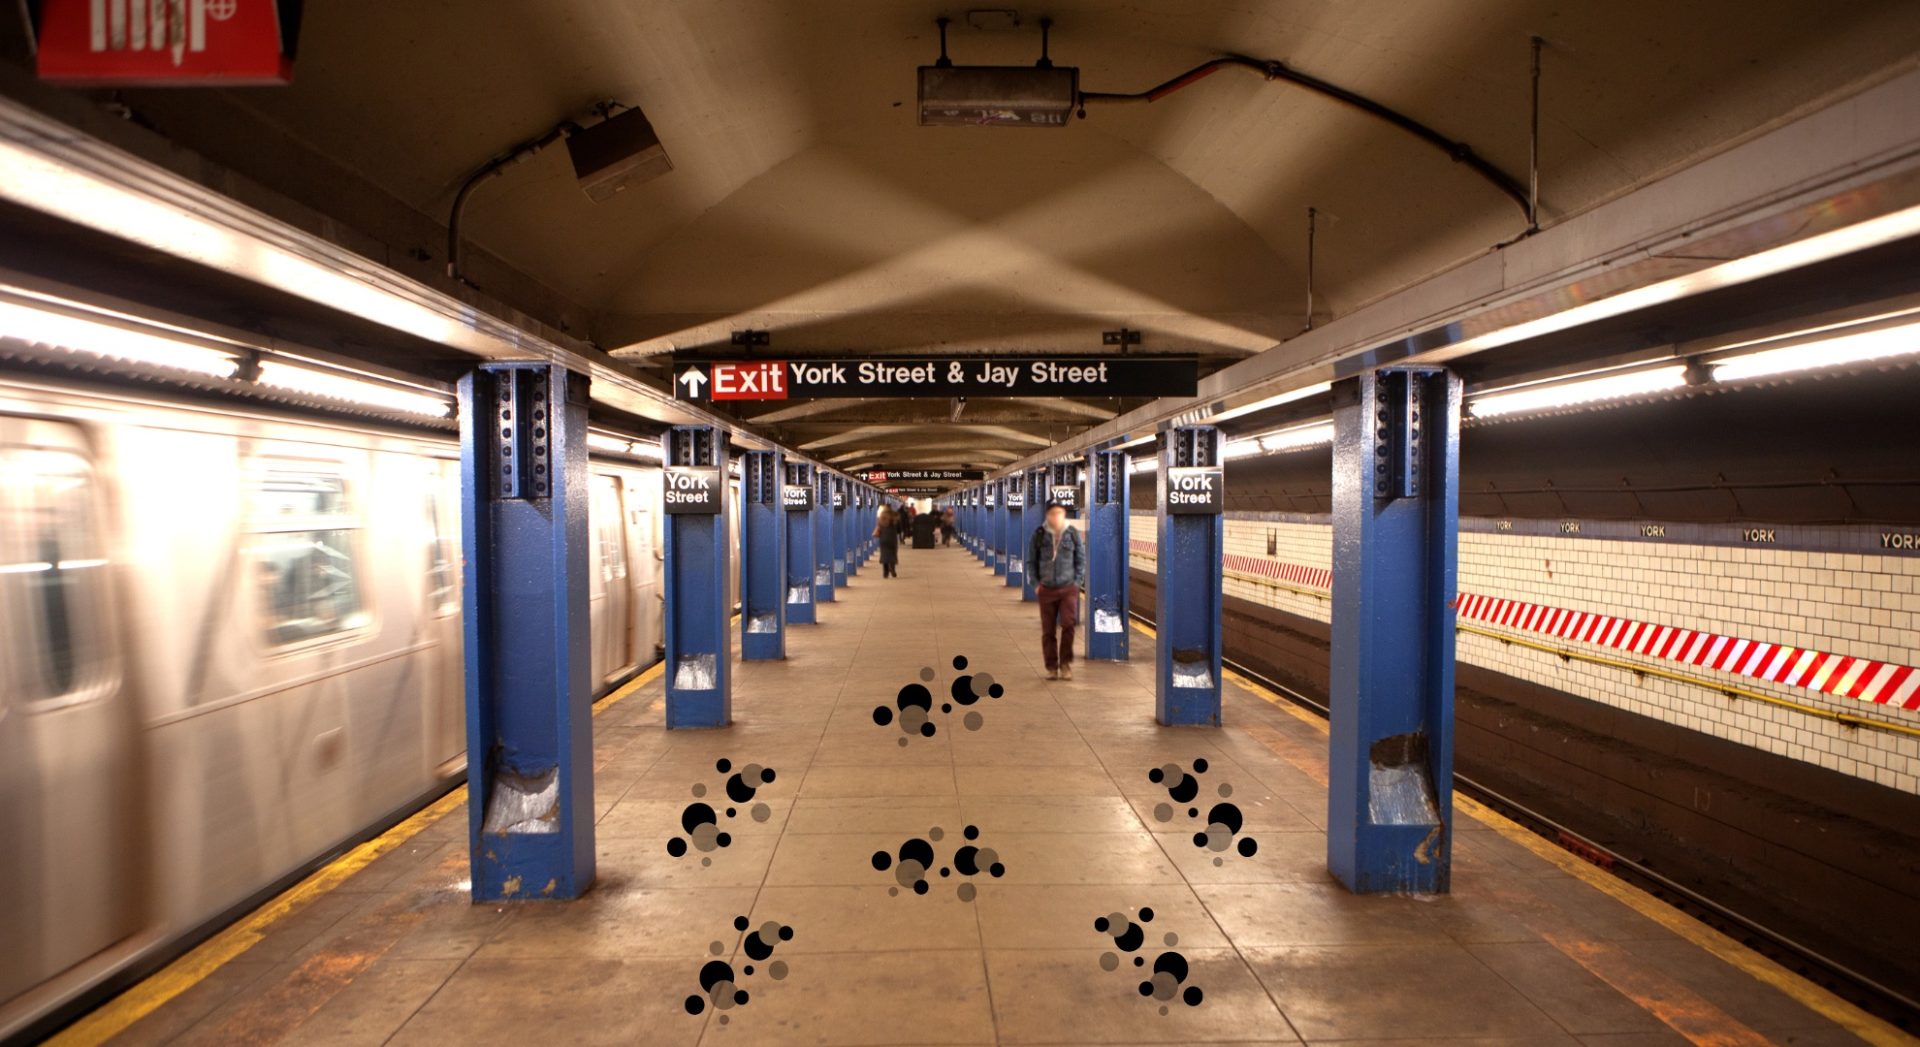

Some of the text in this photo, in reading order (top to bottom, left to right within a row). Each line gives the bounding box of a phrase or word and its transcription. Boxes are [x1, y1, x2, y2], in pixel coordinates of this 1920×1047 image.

[714, 361, 1107, 393] Exit York Street & Jay Street
[666, 472, 710, 490] York
[868, 471, 886, 480] Exit
[931, 471, 941, 479] Jay
[1171, 474, 1213, 490] York
[665, 490, 709, 503] Street
[783, 488, 807, 498] York
[1051, 488, 1075, 498] York
[1169, 491, 1212, 504] Street
[1496, 521, 1513, 531] YORK
[1560, 522, 1581, 533] YORK
[1641, 525, 1665, 538] YORK
[1743, 528, 1776, 543] YORK
